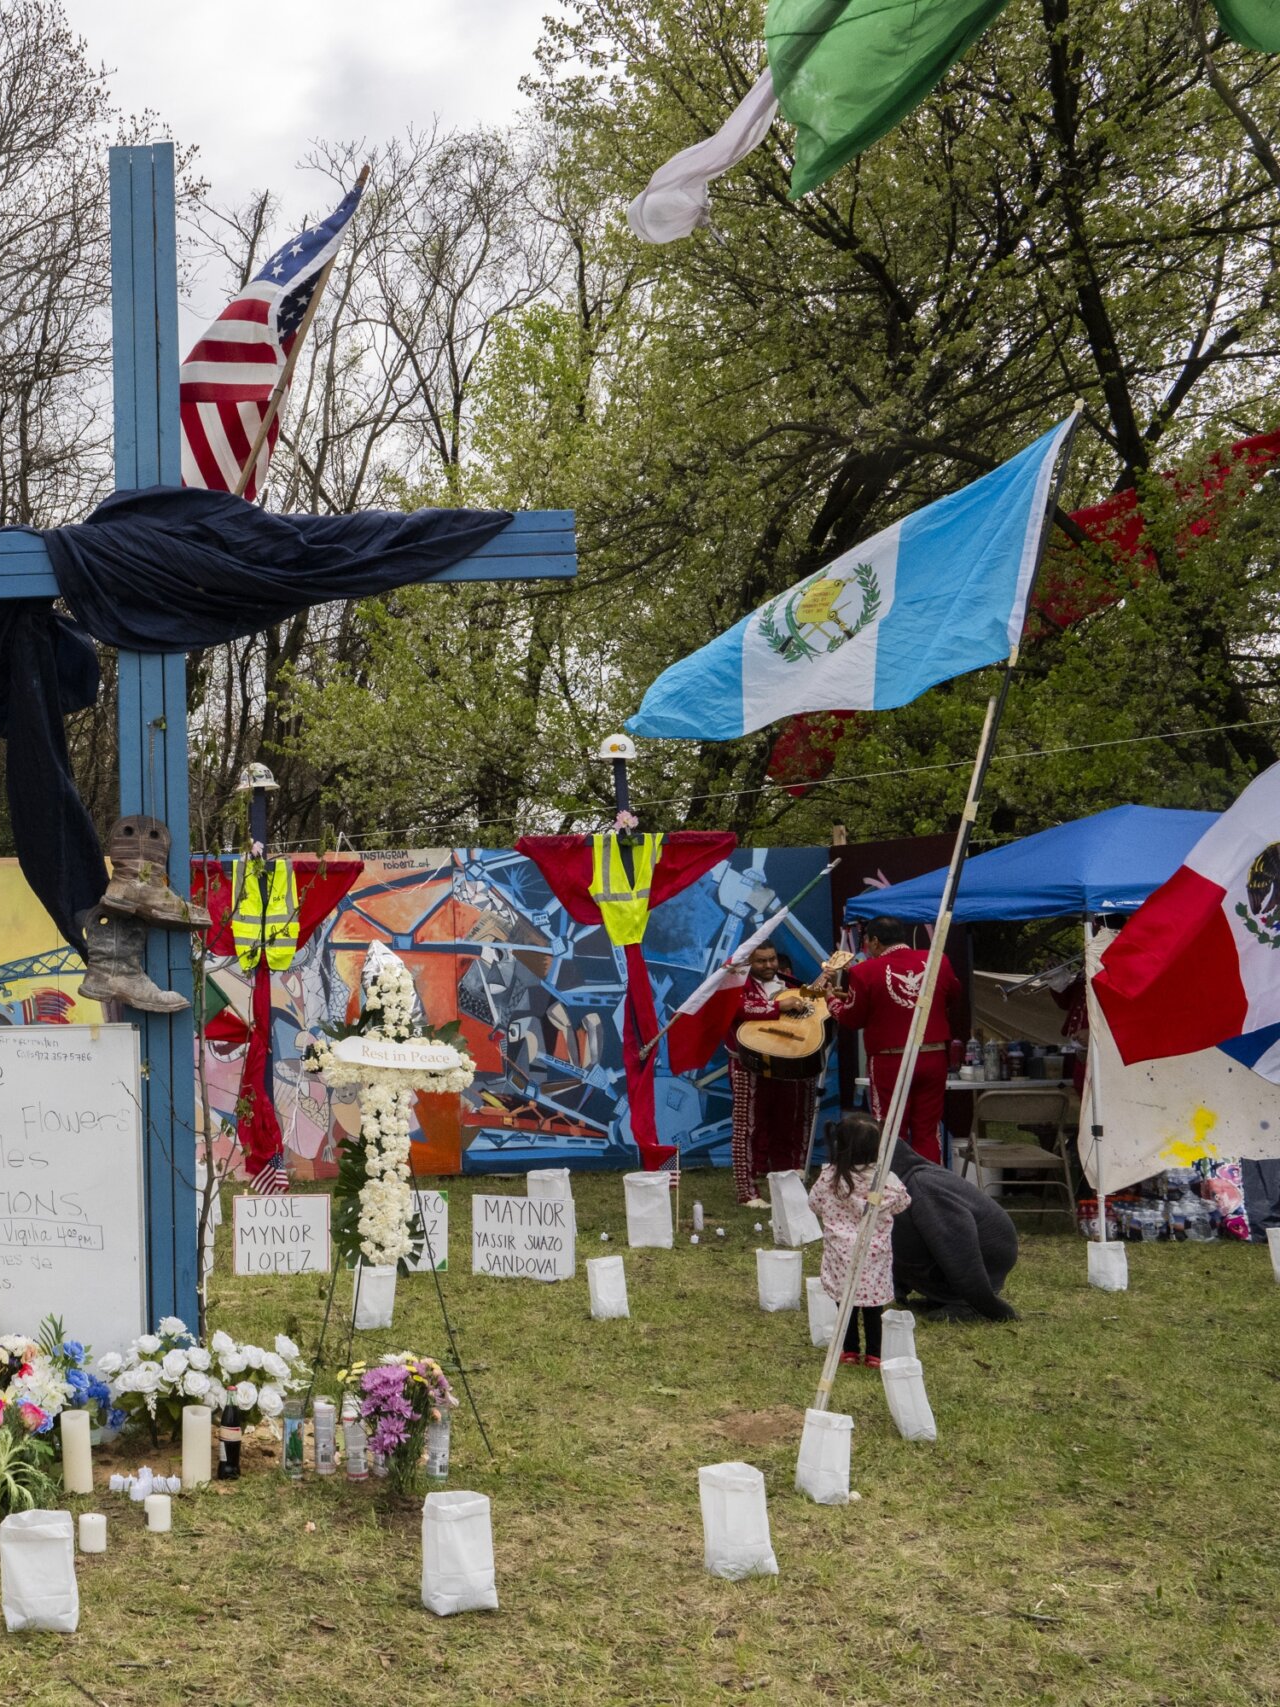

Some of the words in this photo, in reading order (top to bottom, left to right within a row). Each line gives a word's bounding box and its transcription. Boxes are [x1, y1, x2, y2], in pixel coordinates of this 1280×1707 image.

[359, 850, 409, 861] INSTAGRAM
[361, 1045, 389, 1060] Rest
[392, 1050, 407, 1062] in
[410, 1051, 450, 1064] Peace
[21, 1100, 132, 1140] Flowers
[247, 1197, 303, 1218] JOSE
[484, 1199, 566, 1228] MAYNOR
[3, 1219, 52, 1246] Vigilia
[240, 1224, 315, 1246] MYNOR
[475, 1231, 517, 1250] YASSIR
[524, 1234, 563, 1252] SUAZO
[30, 1251, 54, 1270] de
[247, 1249, 315, 1272] LOPEZ
[480, 1252, 564, 1276] SANDOVAL
